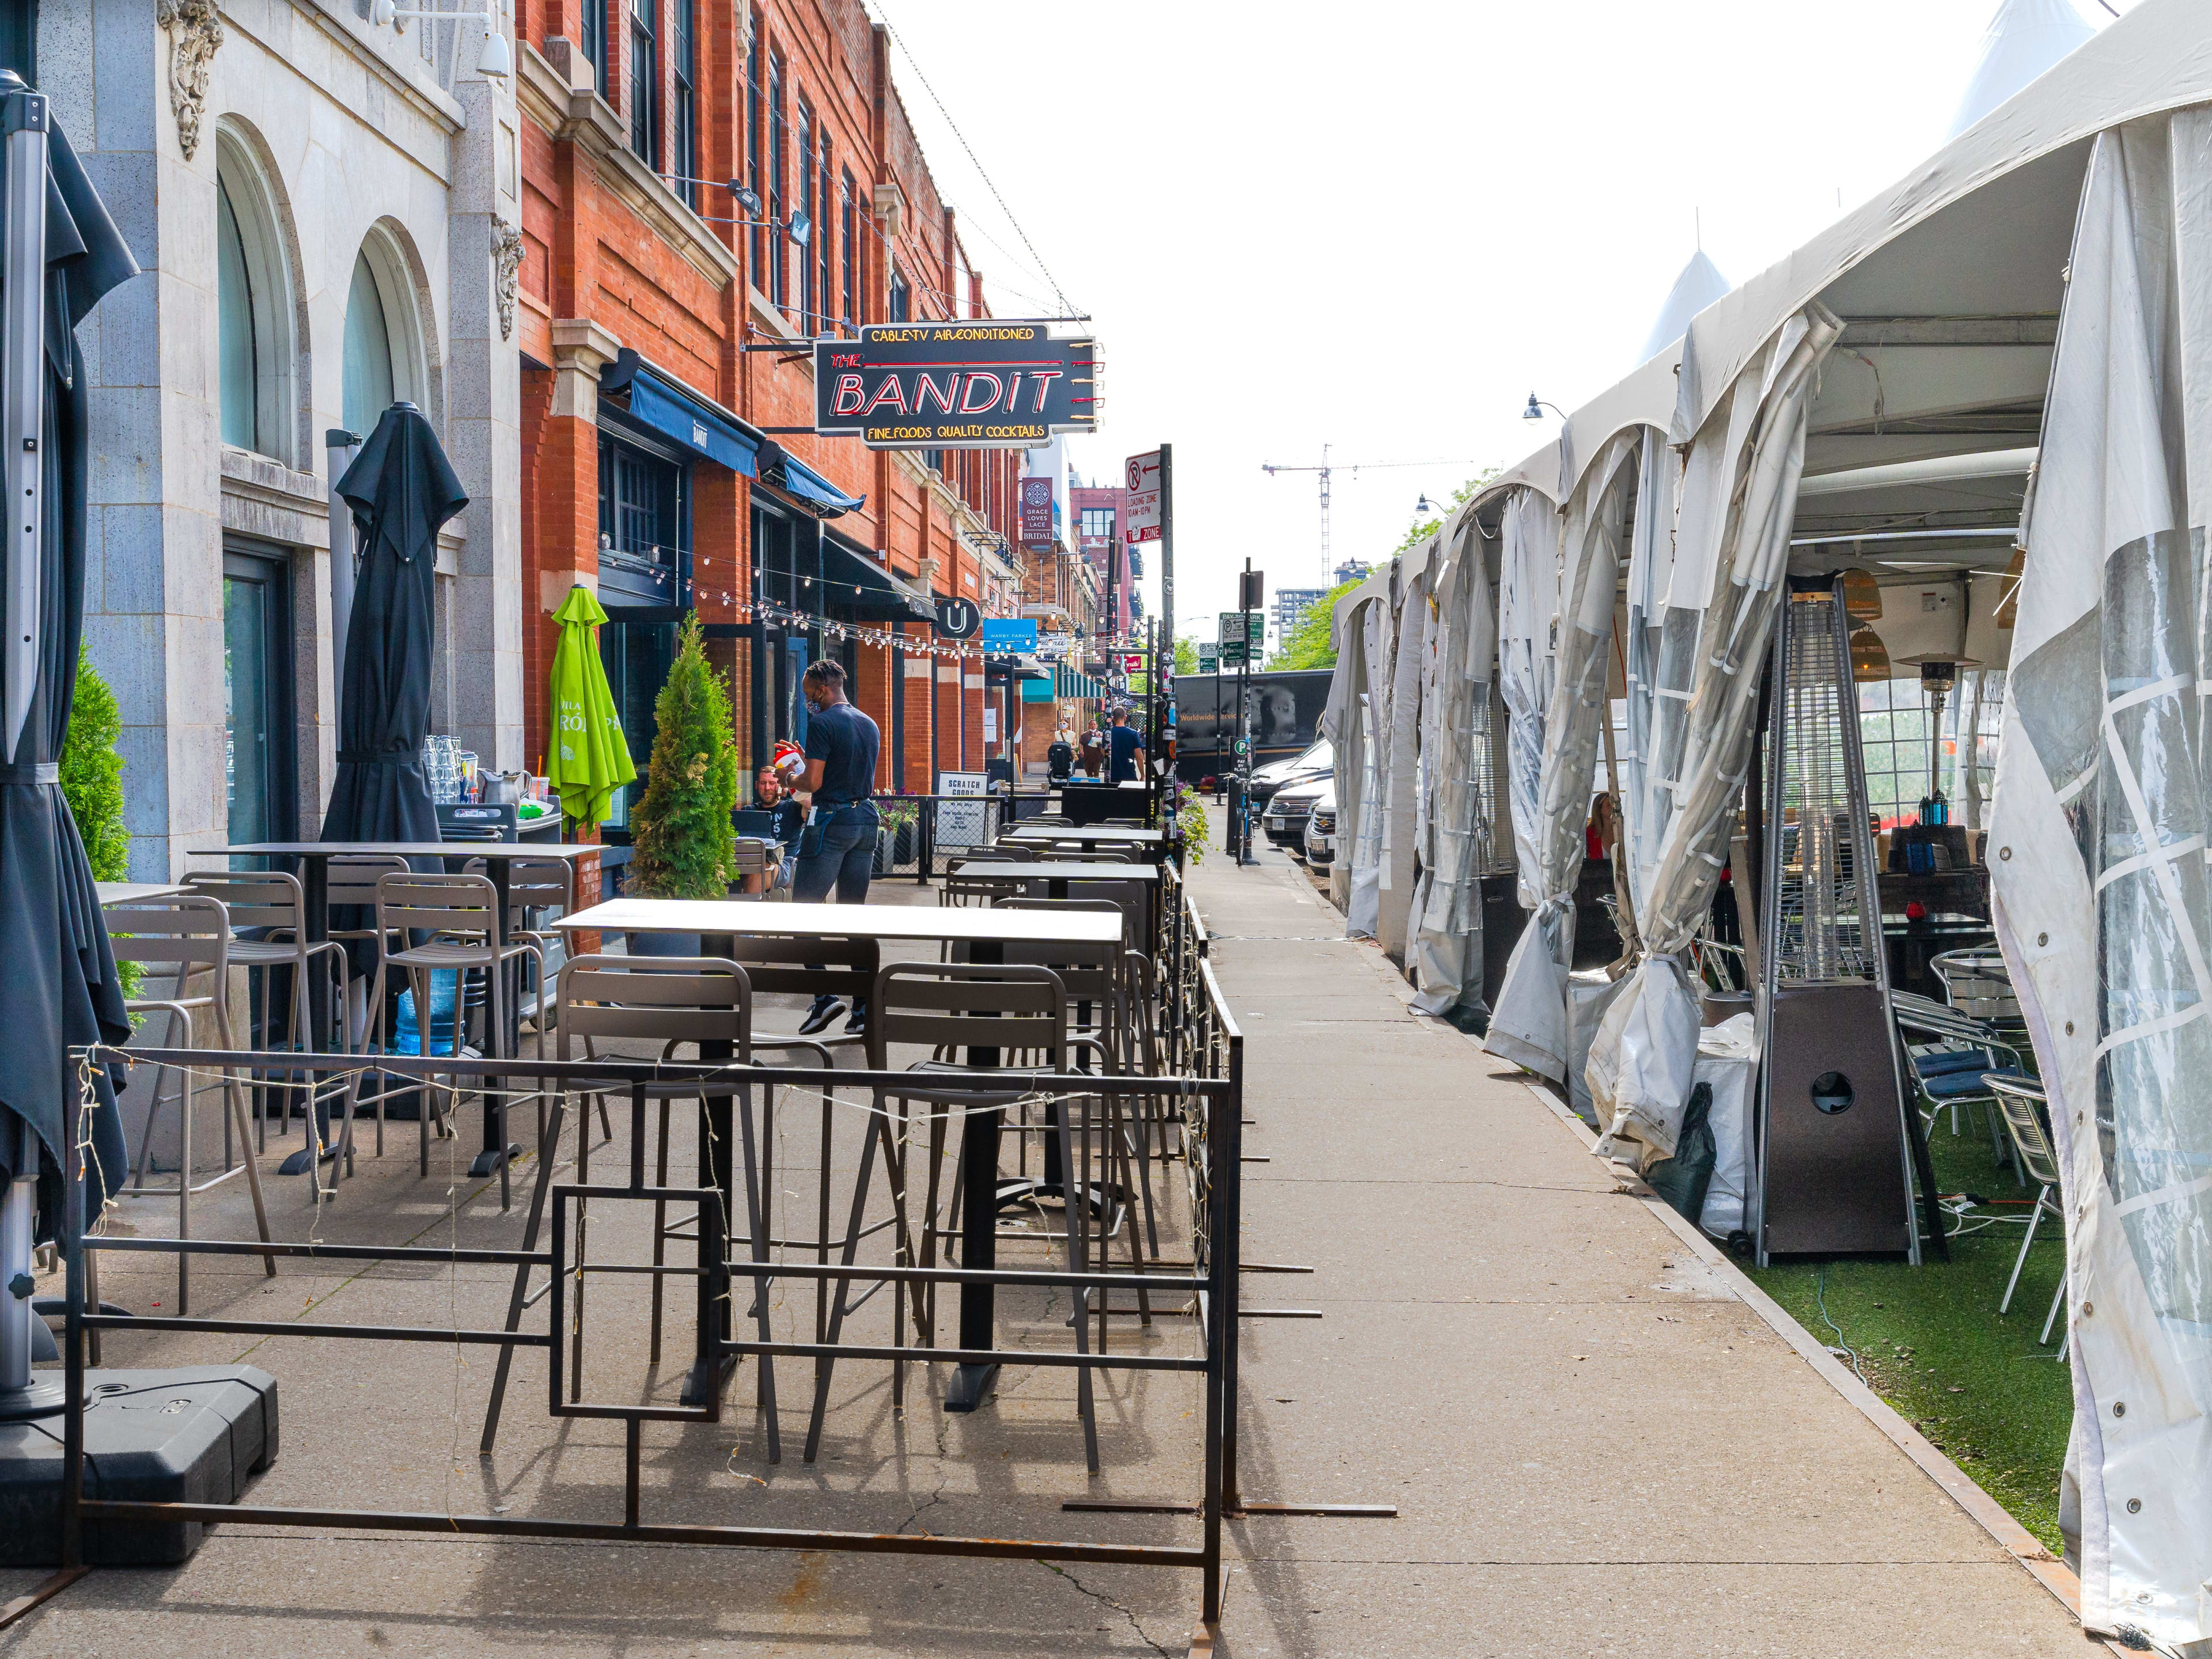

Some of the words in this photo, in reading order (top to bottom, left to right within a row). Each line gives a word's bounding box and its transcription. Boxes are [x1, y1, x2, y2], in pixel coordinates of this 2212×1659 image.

[831, 354, 861, 369] THE
[829, 371, 1064, 416] BANDIT
[893, 426, 932, 438] FOODS
[937, 425, 983, 438] QUALITY
[986, 425, 1045, 438] COCKTAILS
[1128, 496, 1145, 507] LOADING
[1146, 494, 1157, 503] ZONE
[1143, 527, 1160, 539] ZONE
[1180, 714, 1215, 722] Worldwide
[948, 779, 980, 789] SCRATCH
